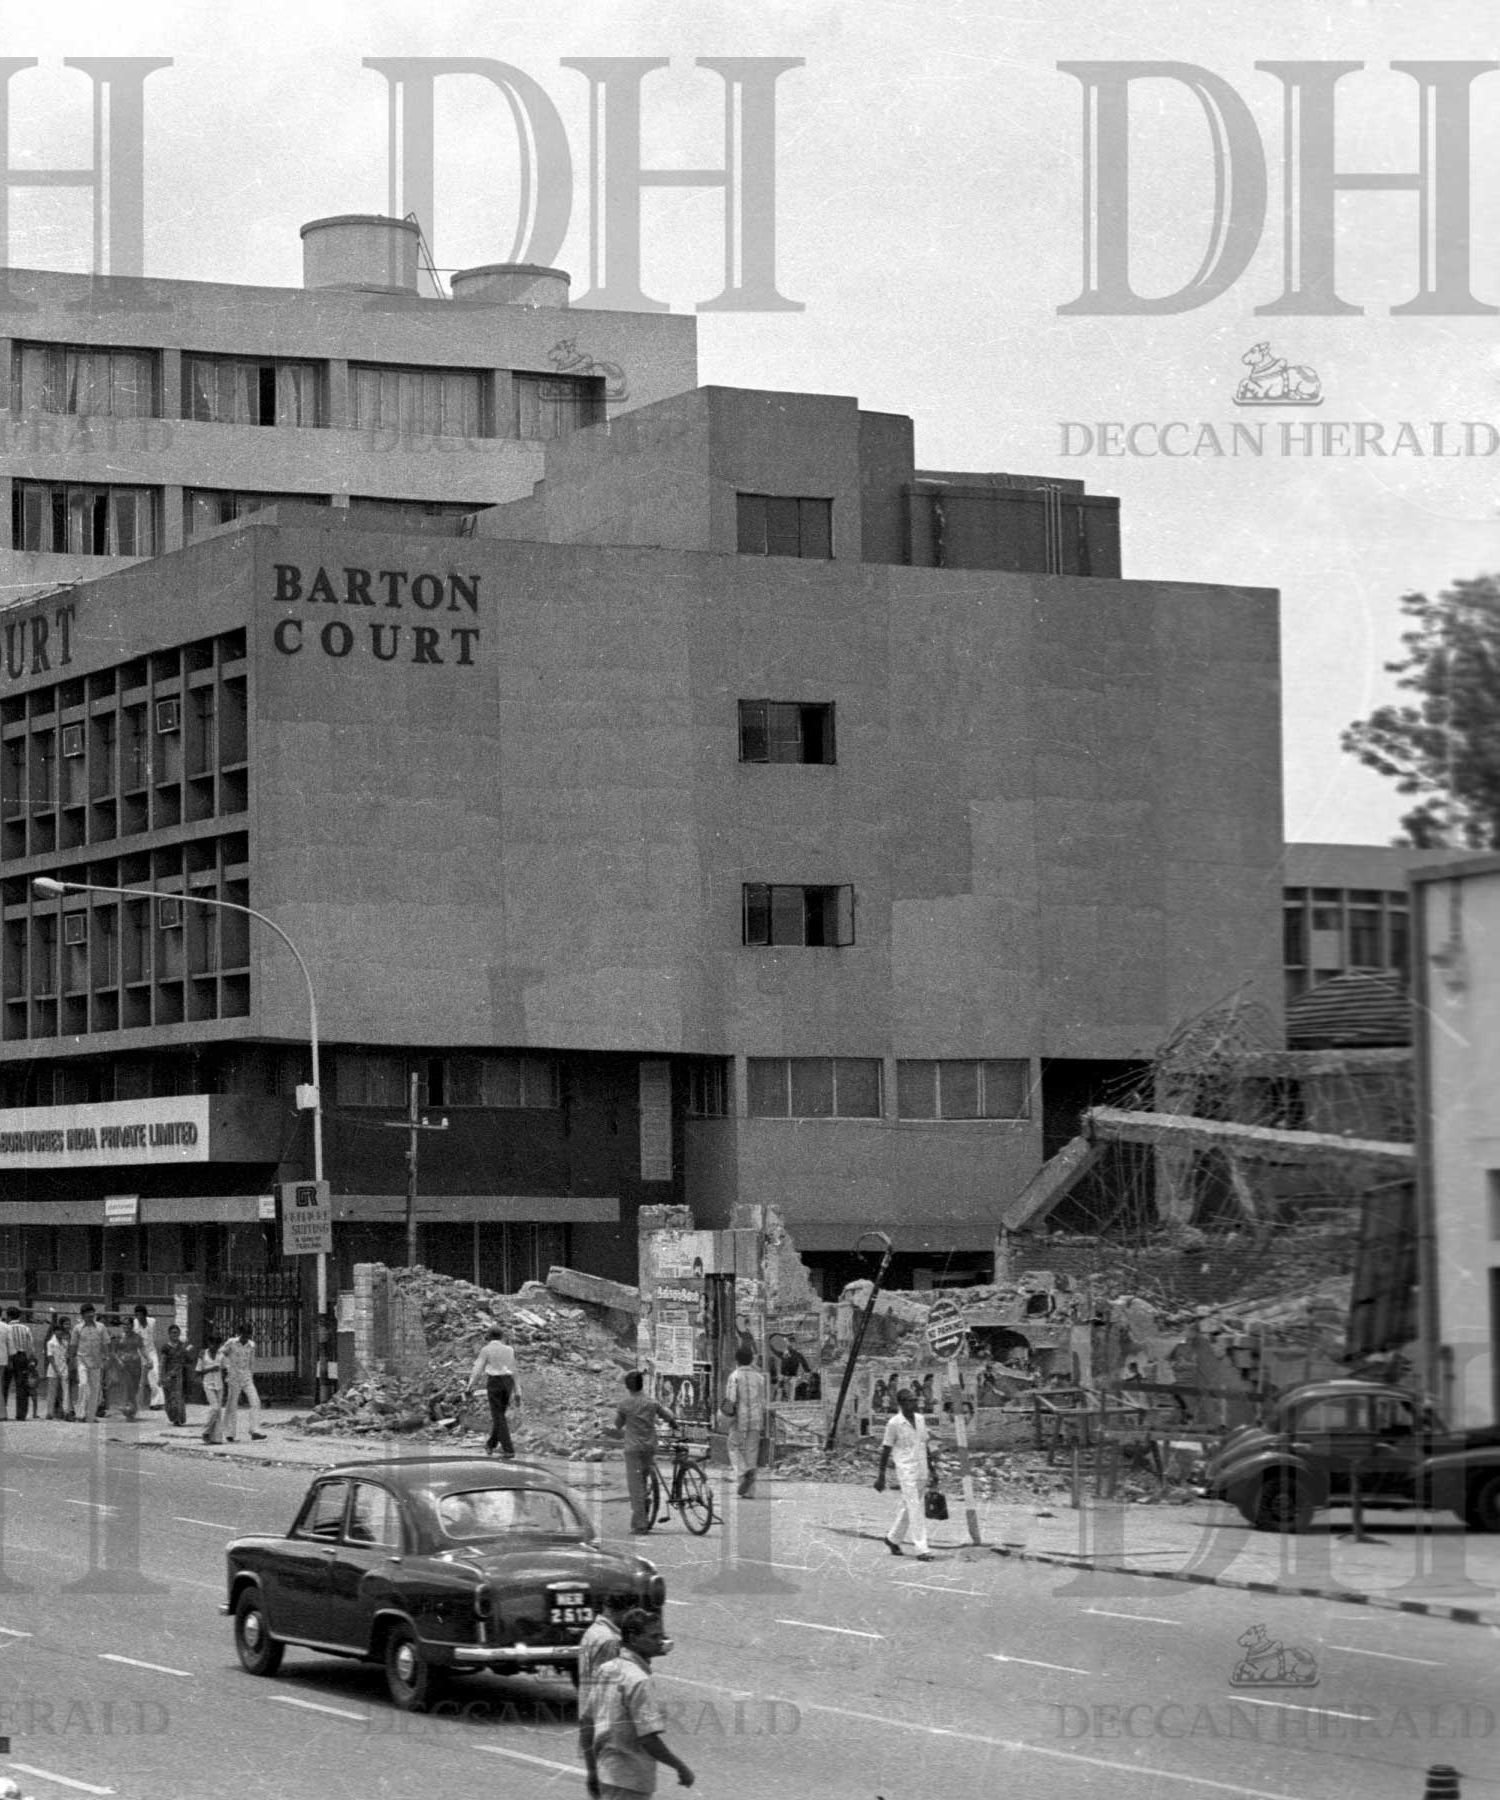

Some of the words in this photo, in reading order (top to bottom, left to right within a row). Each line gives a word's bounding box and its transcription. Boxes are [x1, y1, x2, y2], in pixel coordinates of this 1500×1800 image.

[272, 563, 482, 612] BARTON
[272, 619, 481, 666] COURT
[66, 1127, 97, 1151] INDIA
[100, 1124, 147, 1149] PRIVATE
[148, 1121, 199, 1146] LIMITED
[551, 1607, 594, 1623] 2513
